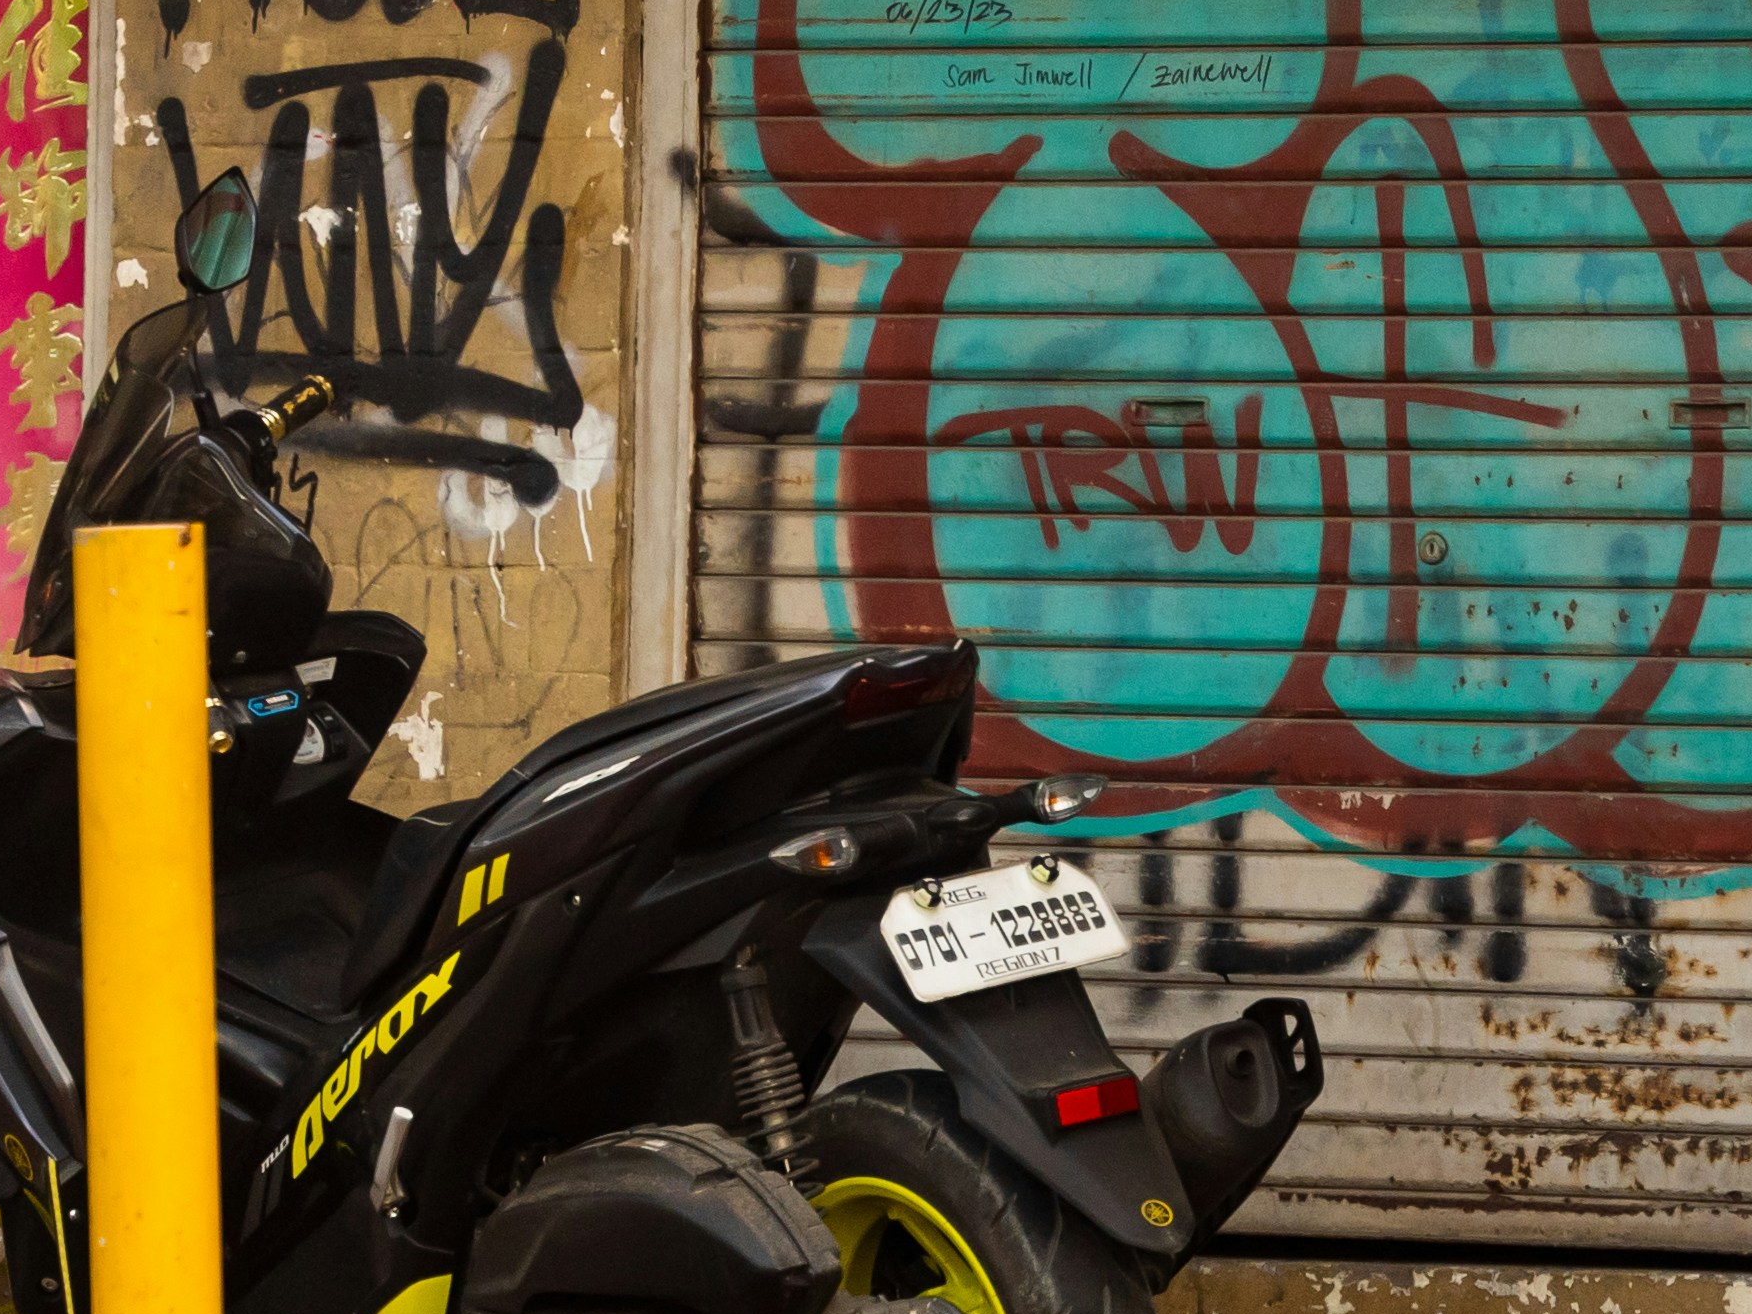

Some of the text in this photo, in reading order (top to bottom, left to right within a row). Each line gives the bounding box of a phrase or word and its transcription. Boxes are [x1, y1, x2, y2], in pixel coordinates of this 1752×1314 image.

[942, 63, 994, 87] Sam
[1014, 58, 1094, 88] Jimwell
[894, 921, 968, 971] 0701
[989, 890, 1107, 949] 1228883
[975, 950, 1047, 978] REGION
